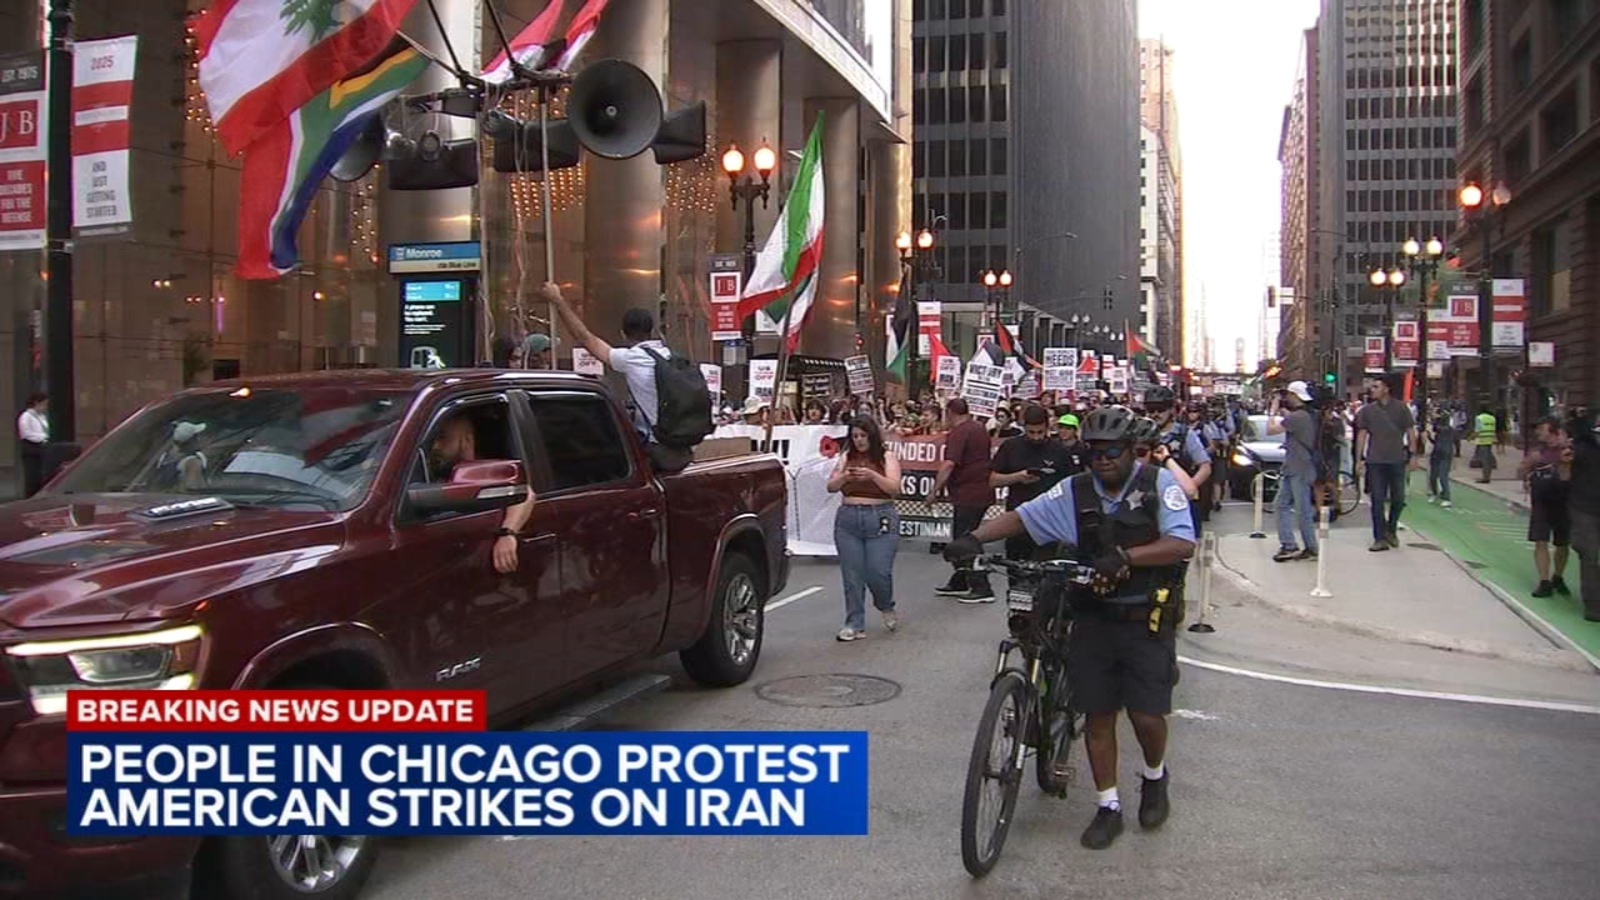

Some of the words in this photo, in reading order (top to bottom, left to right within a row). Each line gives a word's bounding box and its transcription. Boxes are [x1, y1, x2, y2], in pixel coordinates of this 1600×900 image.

[20, 110, 34, 135] B
[405, 247, 442, 259] Monroe
[1045, 354, 1075, 367] NEEDS
[435, 656, 481, 682] RAM
